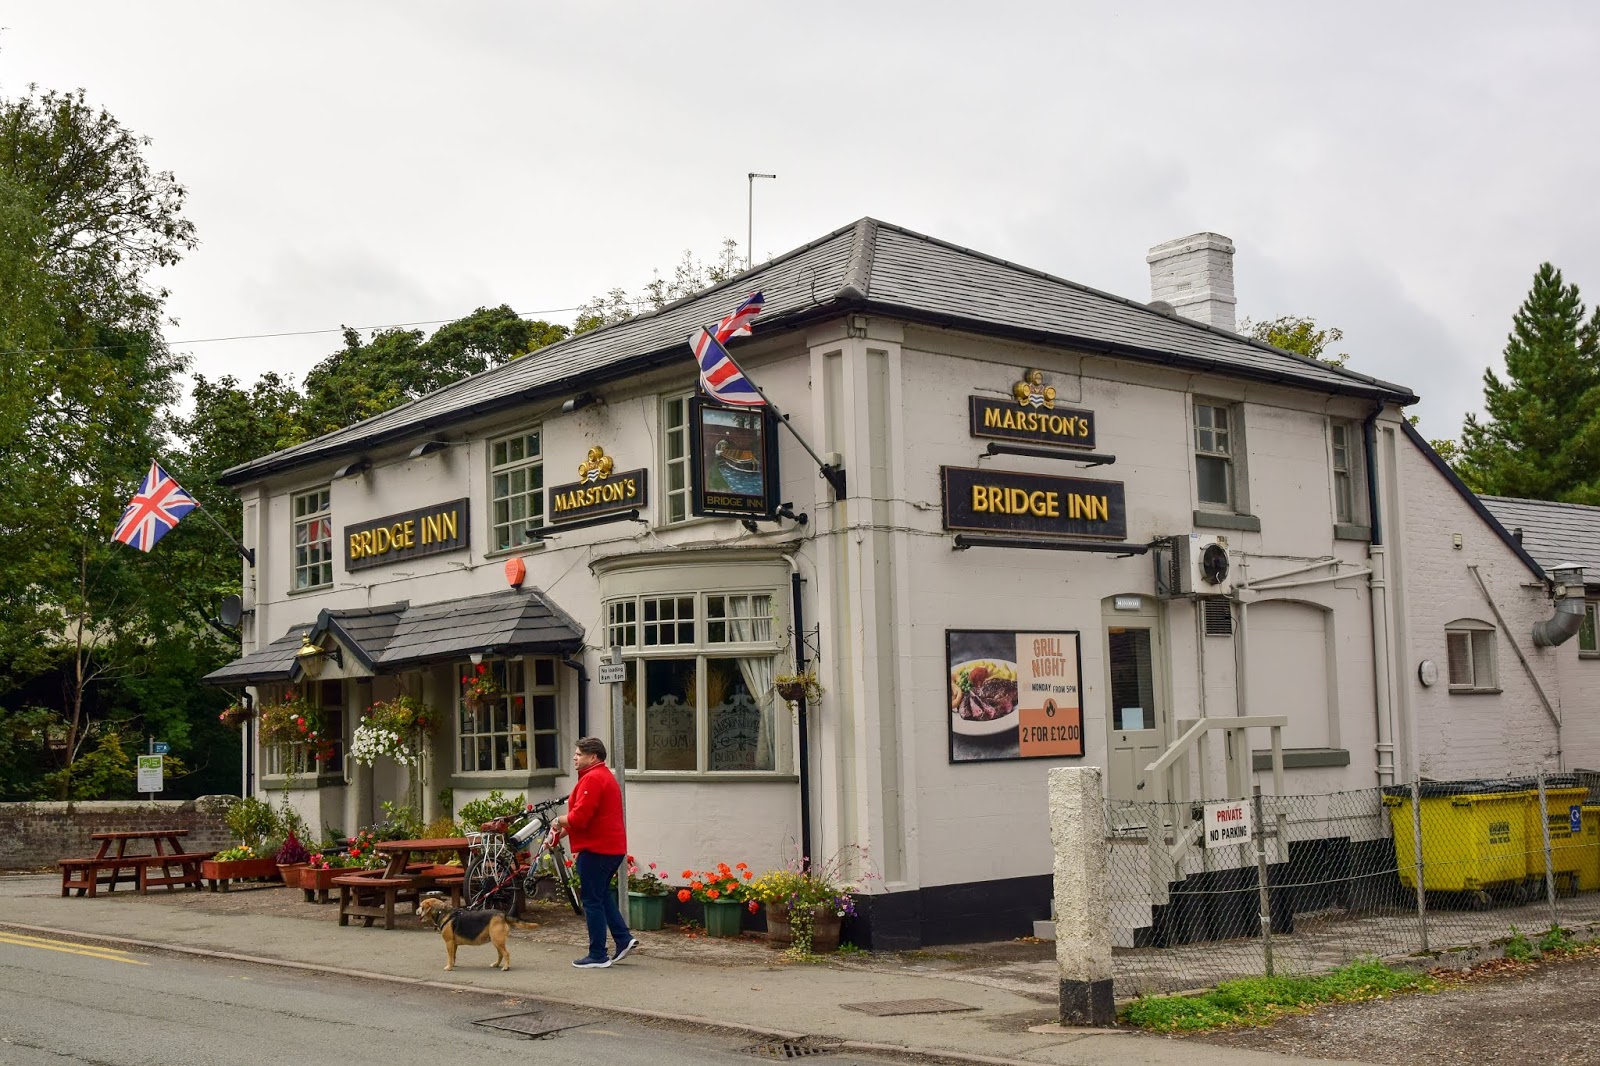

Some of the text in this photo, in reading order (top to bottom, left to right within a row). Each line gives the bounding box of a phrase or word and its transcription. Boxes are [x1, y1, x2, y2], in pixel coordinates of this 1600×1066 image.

[984, 407, 1088, 437] MARSTON'S
[553, 478, 637, 512] MARSTON'S
[706, 495, 763, 508] BRIDGE INN
[971, 485, 1109, 522] BRIDGE INN
[349, 510, 458, 560] BRIDGE INN
[1033, 638, 1063, 657] GRILL
[1031, 658, 1066, 678] NIGHT
[1031, 683, 1077, 694] MONDAY FROM 5PM
[1022, 724, 1080, 742] 2 FOR £12.00
[1217, 808, 1242, 822] PRIVATE
[1210, 825, 1247, 841] NO PARKING
